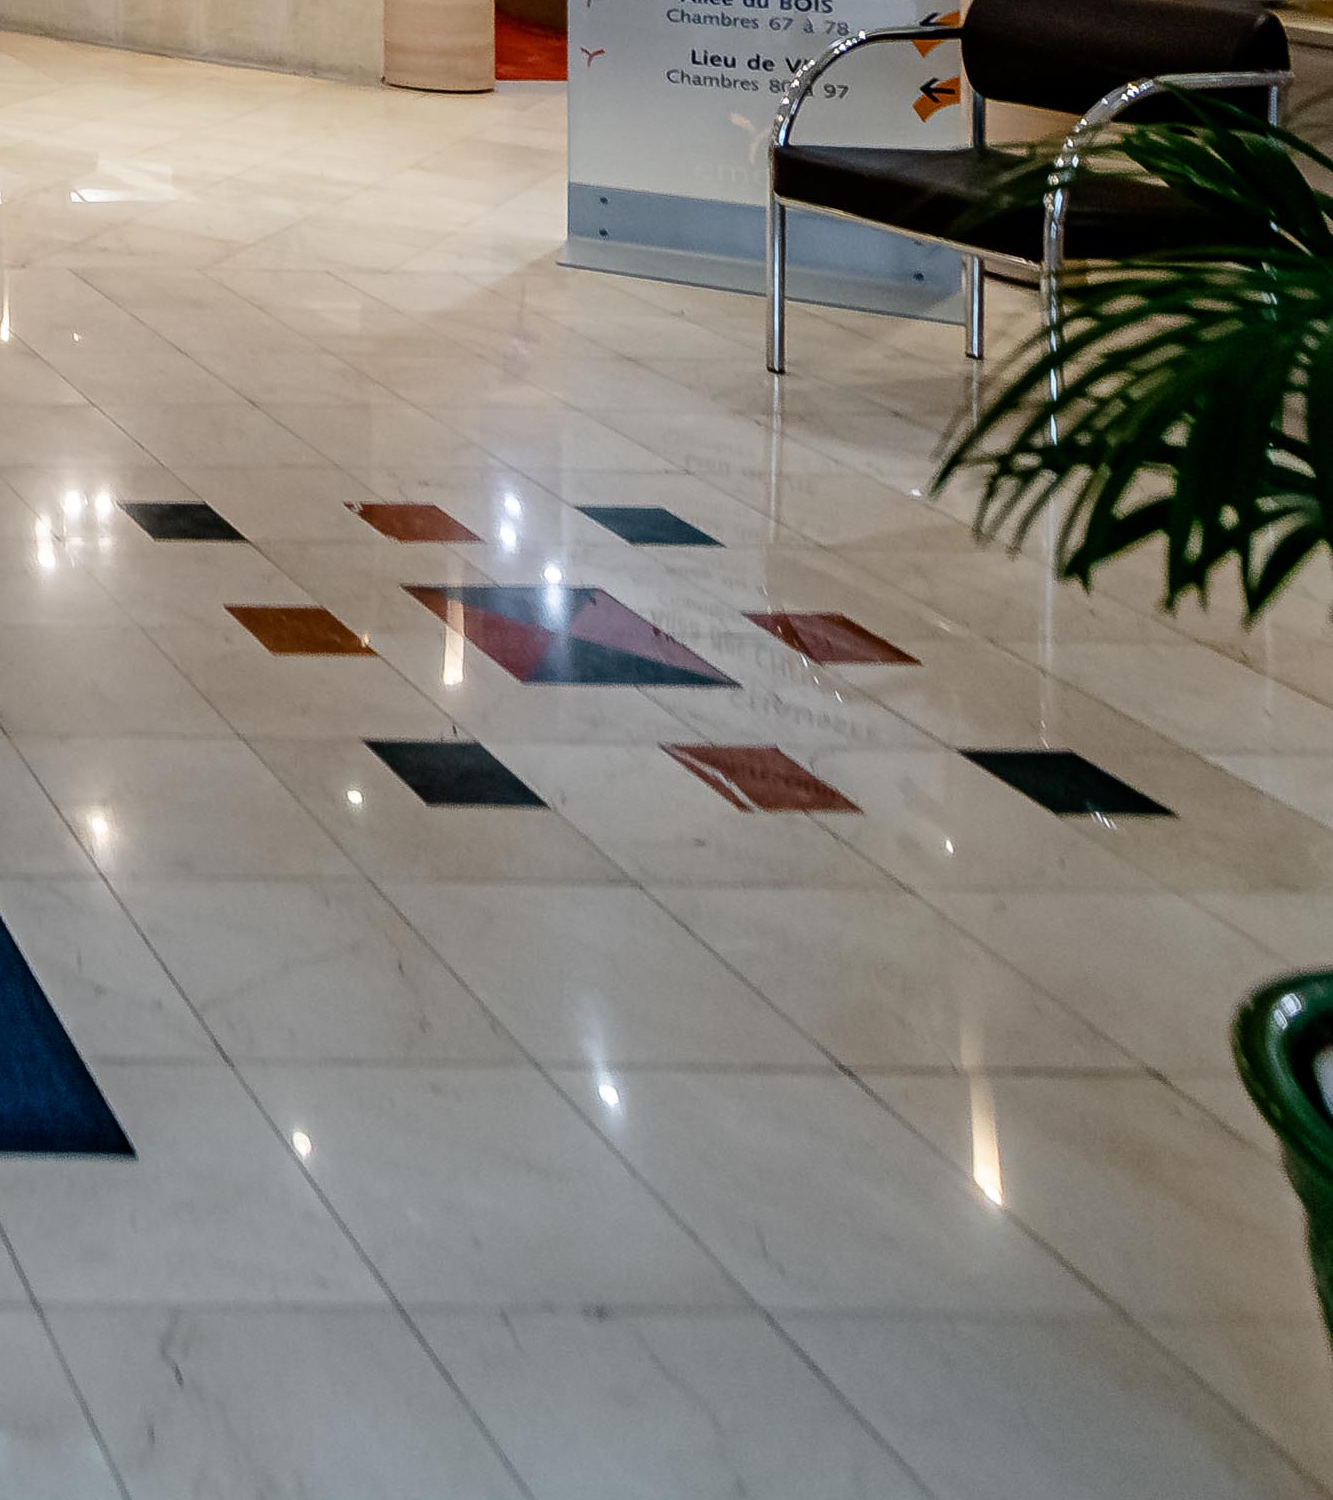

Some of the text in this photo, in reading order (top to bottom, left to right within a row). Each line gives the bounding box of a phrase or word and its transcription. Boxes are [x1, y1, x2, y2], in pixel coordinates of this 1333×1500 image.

[666, 7, 851, 36] Chambres 67 à 78
[691, 49, 736, 68] Lieu
[747, 53, 775, 72] de
[666, 67, 760, 91] Chambres
[824, 83, 848, 100] 97
